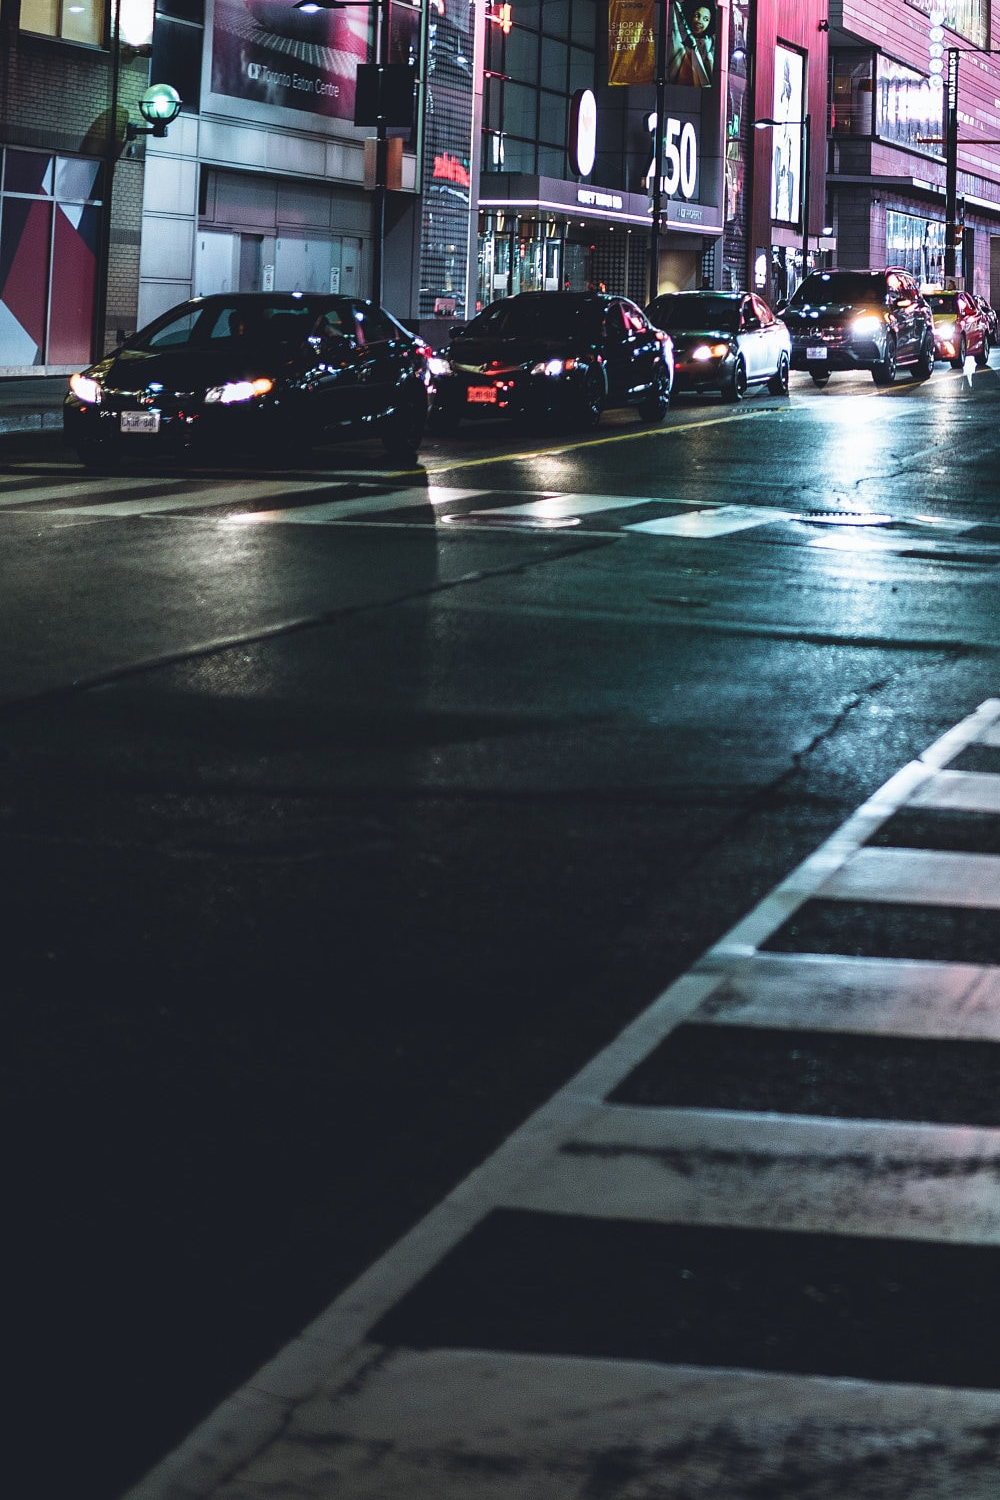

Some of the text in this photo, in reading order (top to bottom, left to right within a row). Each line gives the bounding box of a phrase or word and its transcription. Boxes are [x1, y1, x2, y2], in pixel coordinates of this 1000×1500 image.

[611, 20, 644, 29] SHOP IN
[614, 35, 655, 44] CULTURAL
[610, 43, 637, 51] HEART
[262, 65, 291, 87] Toronto
[292, 73, 313, 93] Eaton
[314, 78, 340, 98] Centre
[948, 52, 957, 109] DOWNTOWN
